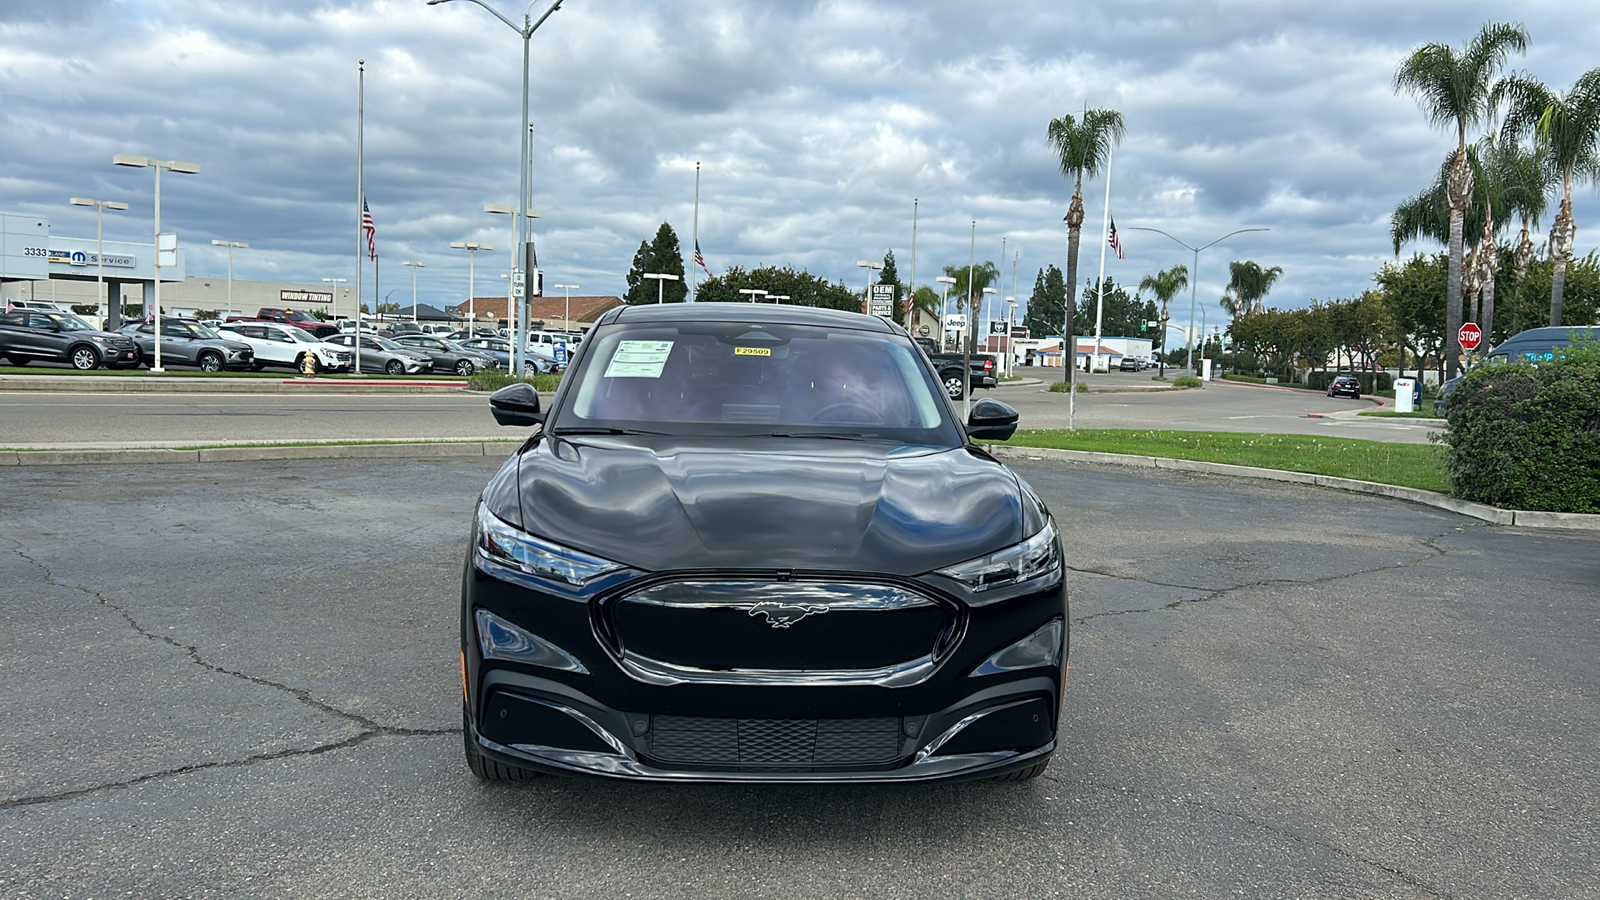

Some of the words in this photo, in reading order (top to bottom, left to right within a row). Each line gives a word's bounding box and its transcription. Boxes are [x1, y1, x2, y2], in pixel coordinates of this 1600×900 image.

[24, 247, 47, 257] 3333
[91, 255, 130, 265] Srvice
[873, 286, 892, 294] OEM
[282, 292, 308, 300] WINDOW
[947, 319, 966, 328] Jeep
[1460, 330, 1480, 342] STOP
